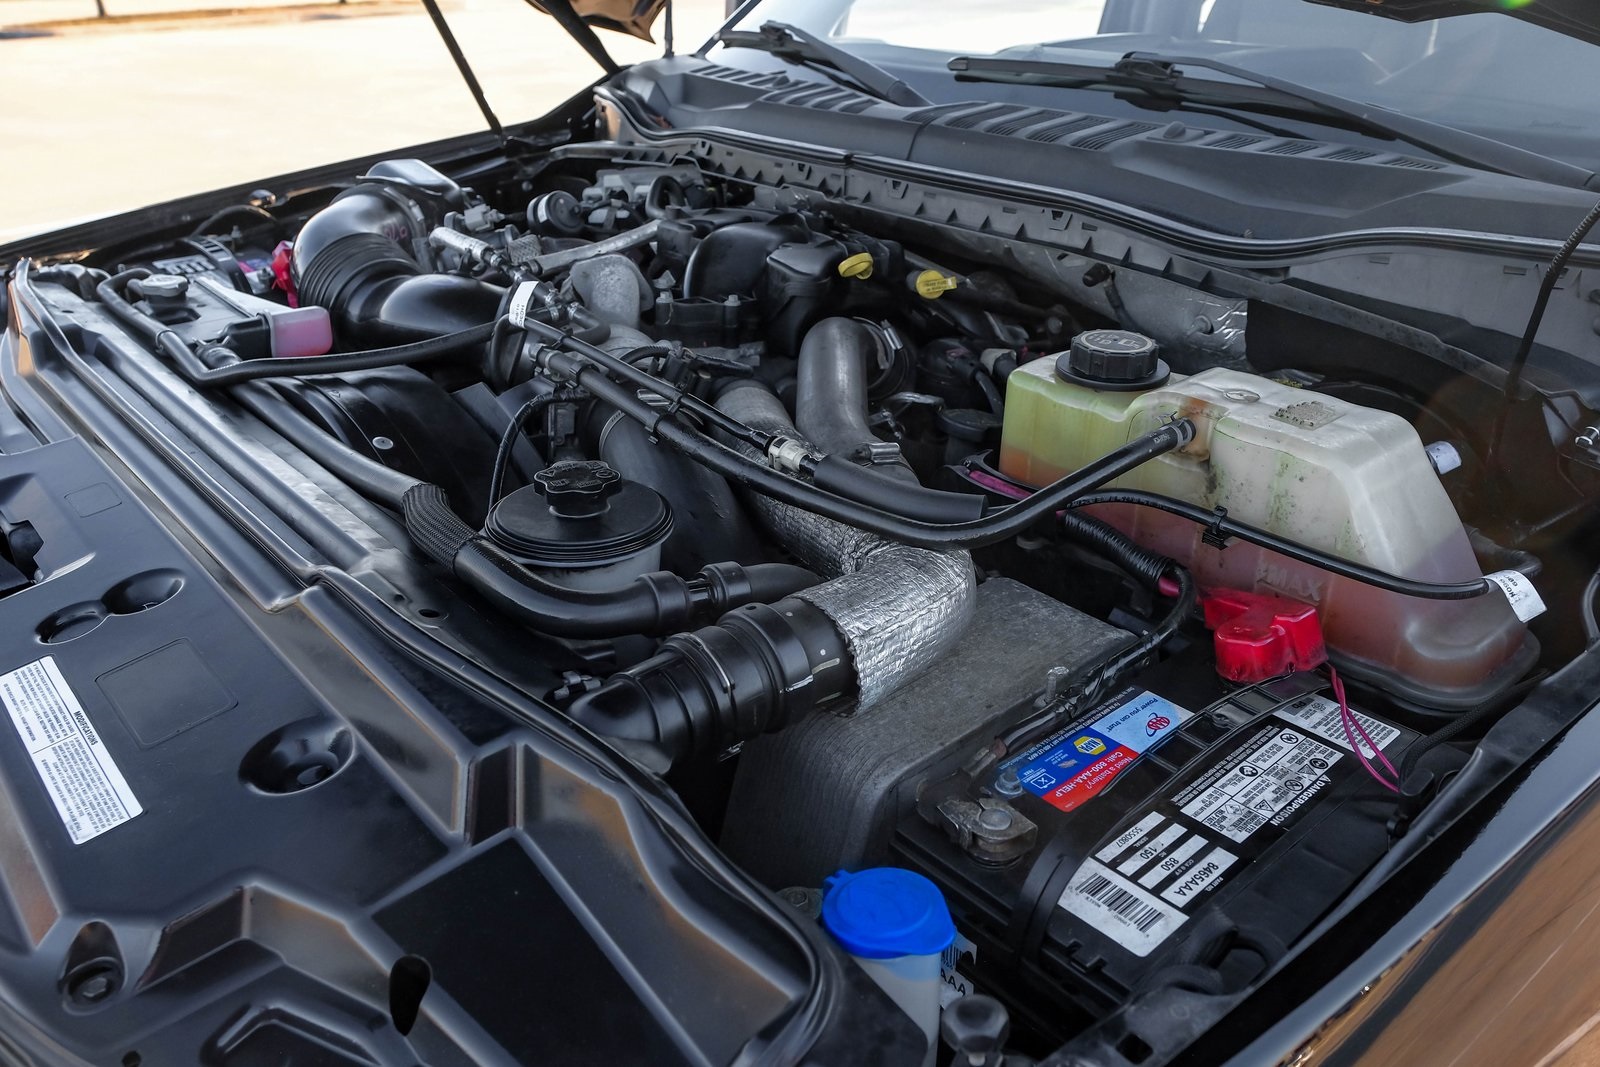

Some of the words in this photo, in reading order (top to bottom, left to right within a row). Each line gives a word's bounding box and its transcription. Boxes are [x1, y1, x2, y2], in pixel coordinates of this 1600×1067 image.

[1138, 697, 1158, 709] Power
[1127, 707, 1141, 715] you
[73, 710, 99, 746] MODIFICATIONS
[1076, 738, 1101, 753] NAPA
[1103, 750, 1123, 763] Call:
[1113, 756, 1132, 768] Need
[1054, 760, 1107, 797] 800-AAA-HELP
[1082, 769, 1112, 789] battery?
[1270, 781, 1324, 826] DANGER/POISON
[1114, 826, 1143, 847] 5550807
[1138, 845, 1158, 860] 150
[1159, 856, 1179, 871] 850
[1173, 861, 1219, 898] 8465AAA
[1210, 876, 1223, 886] PART
